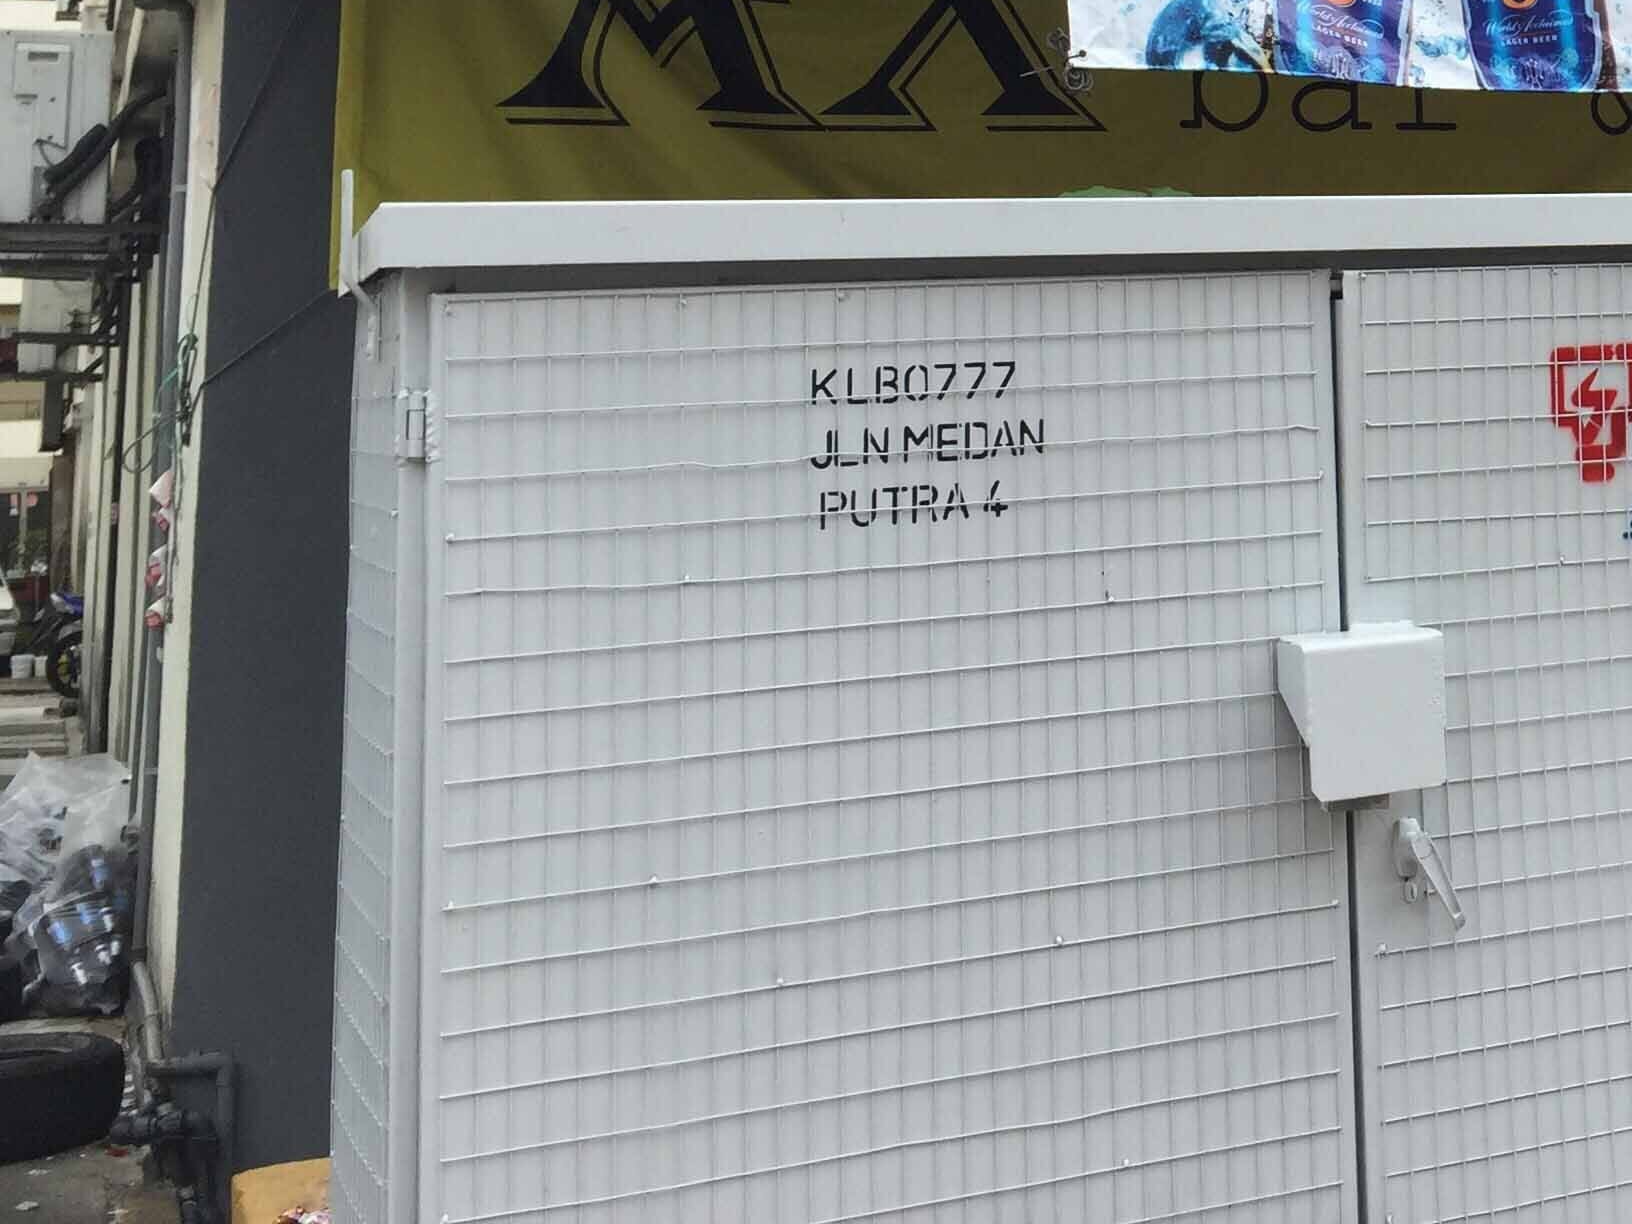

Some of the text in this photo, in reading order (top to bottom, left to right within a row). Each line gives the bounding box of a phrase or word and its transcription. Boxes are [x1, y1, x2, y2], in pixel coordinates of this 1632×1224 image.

[810, 418, 1044, 469] JLN MEDAN
[820, 479, 1009, 530] PUTRA 4
